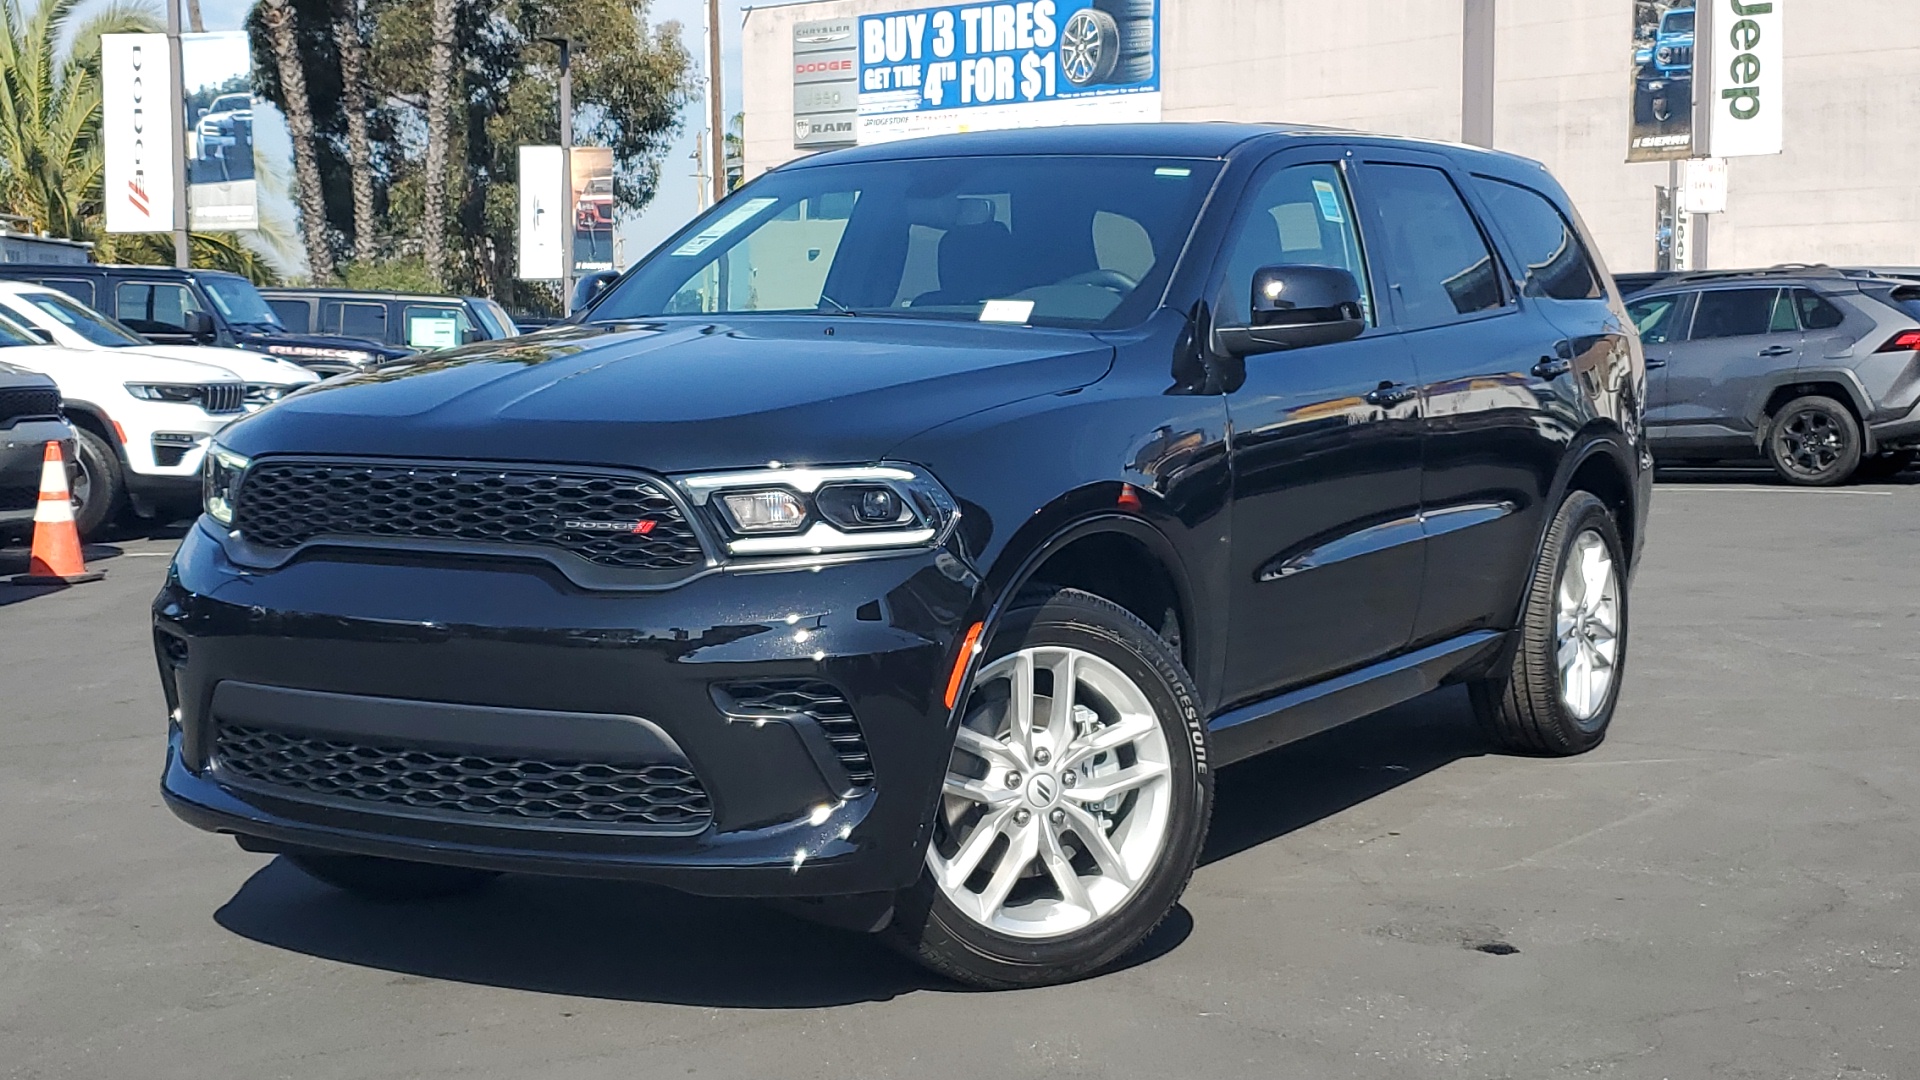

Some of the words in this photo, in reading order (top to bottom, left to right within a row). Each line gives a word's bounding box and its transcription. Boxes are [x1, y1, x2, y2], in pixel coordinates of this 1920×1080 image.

[796, 25, 850, 36] CHRYSLER
[863, 13, 927, 65] BUY
[932, 10, 955, 58] 3
[960, 0, 1057, 55] TIRES
[796, 60, 852, 74] DODGE
[1721, 0, 1773, 120] Jeep
[864, 66, 891, 91] GET
[893, 64, 922, 88] THE
[960, 56, 1015, 104] FOR
[1020, 50, 1056, 102] $1
[804, 90, 841, 108] Jeep
[811, 122, 852, 134] RAM
[565, 520, 643, 531] DODGE
